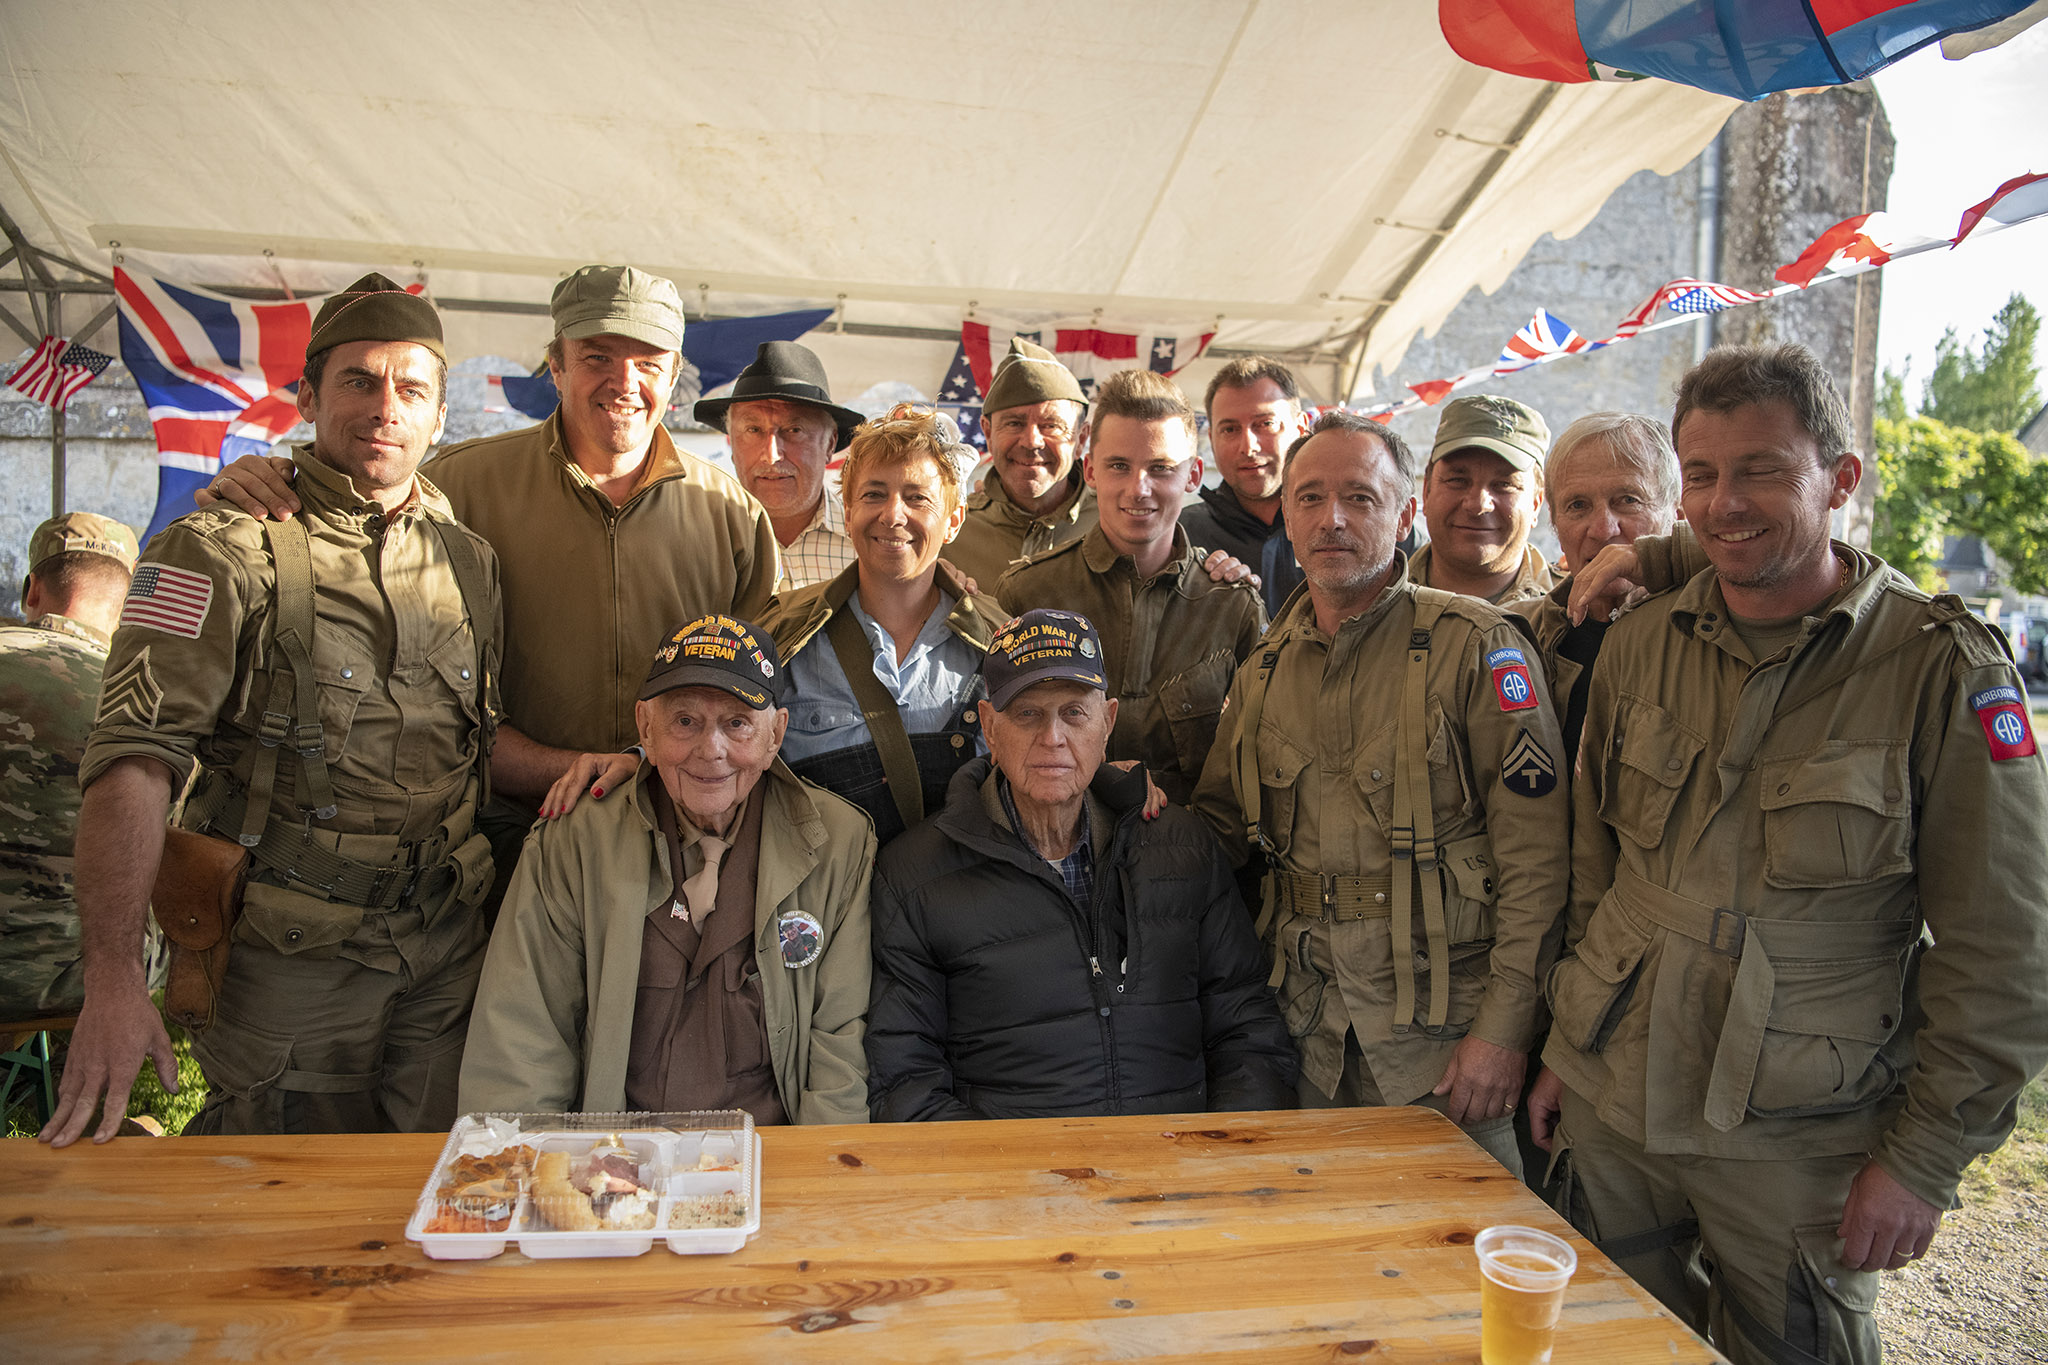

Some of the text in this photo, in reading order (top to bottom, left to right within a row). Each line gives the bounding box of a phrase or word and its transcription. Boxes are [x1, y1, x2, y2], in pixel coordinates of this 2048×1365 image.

[85, 540, 120, 557] McKAY
[671, 614, 716, 643] WORLD
[718, 614, 746, 638] WAR
[1004, 624, 1078, 654] WORLD WAR II
[684, 644, 736, 662] VETERAN
[1013, 648, 1073, 666] VETERAN
[1489, 650, 1523, 664] AIRBORNE
[1975, 688, 2018, 707] AIRBORNE
